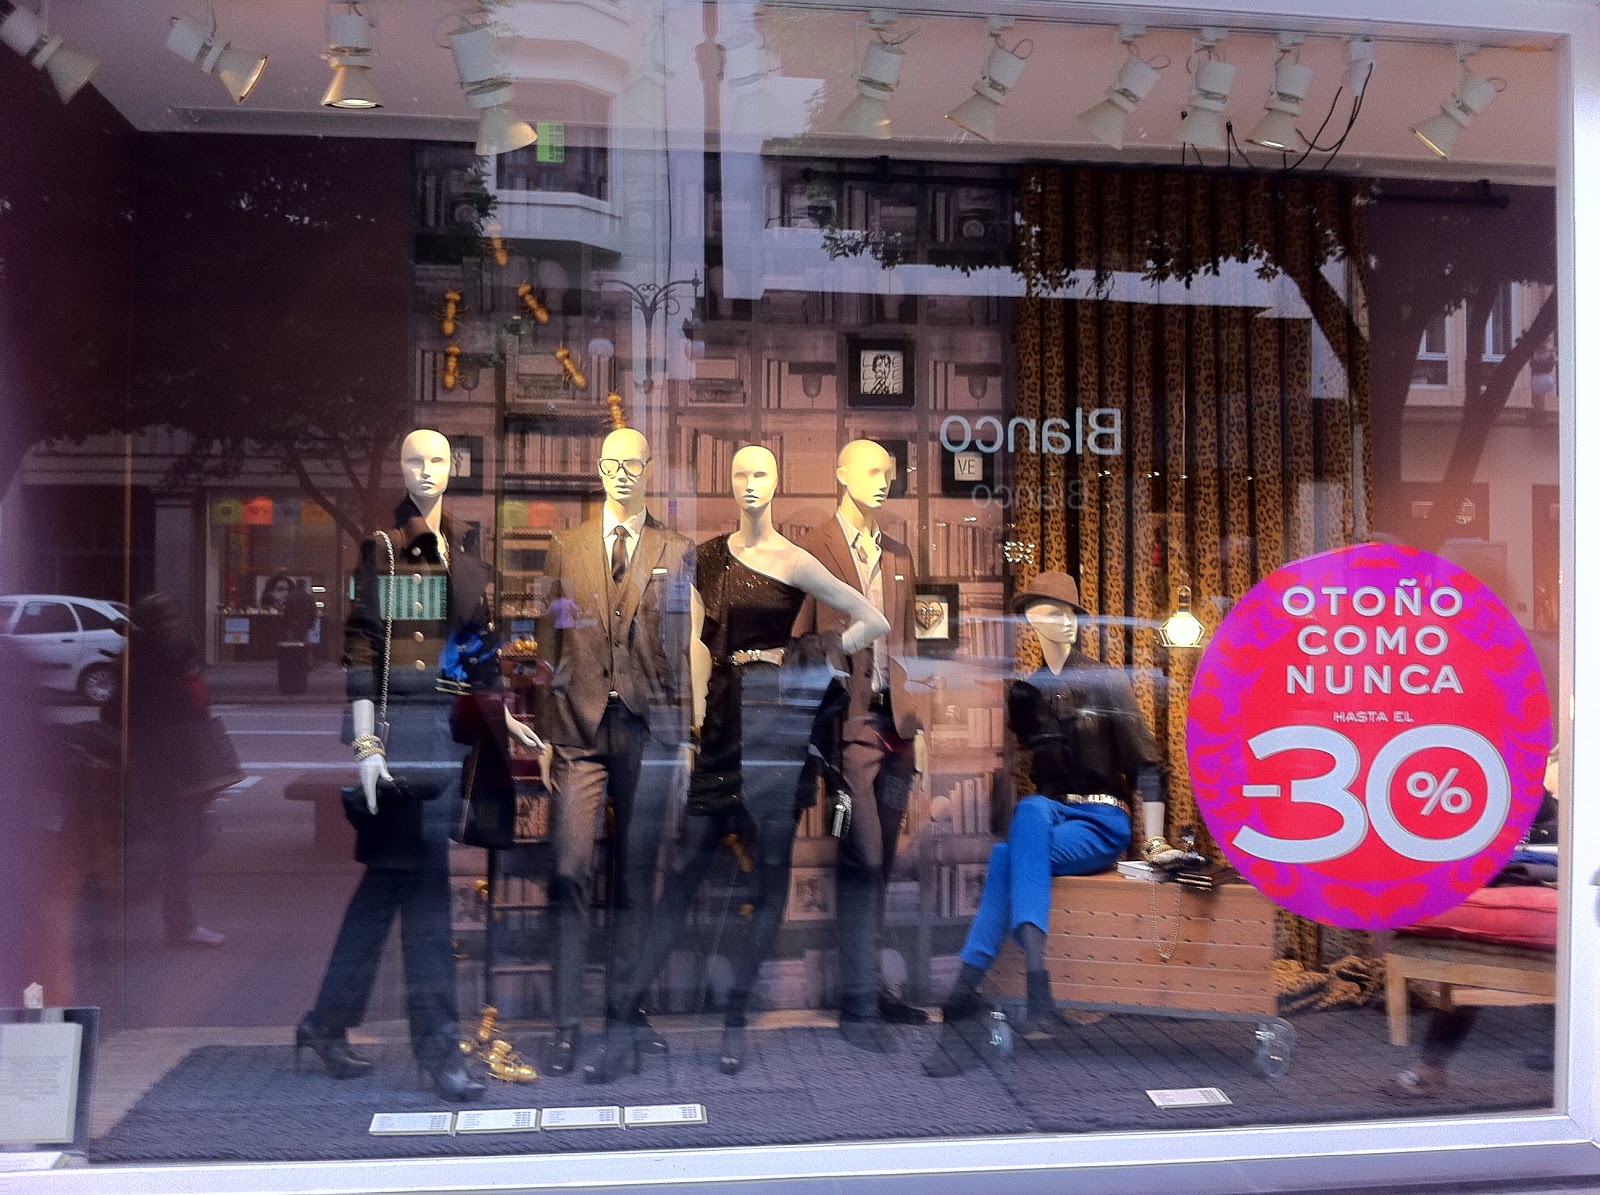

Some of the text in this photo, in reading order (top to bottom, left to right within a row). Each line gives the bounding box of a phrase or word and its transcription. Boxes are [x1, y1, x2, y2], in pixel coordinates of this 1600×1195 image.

[957, 459, 976, 475] VE
[1282, 578, 1463, 617] OTOÑO
[1298, 625, 1449, 656] COMO
[1286, 664, 1464, 695] NUNCA
[1333, 710, 1414, 724] HASTA EL
